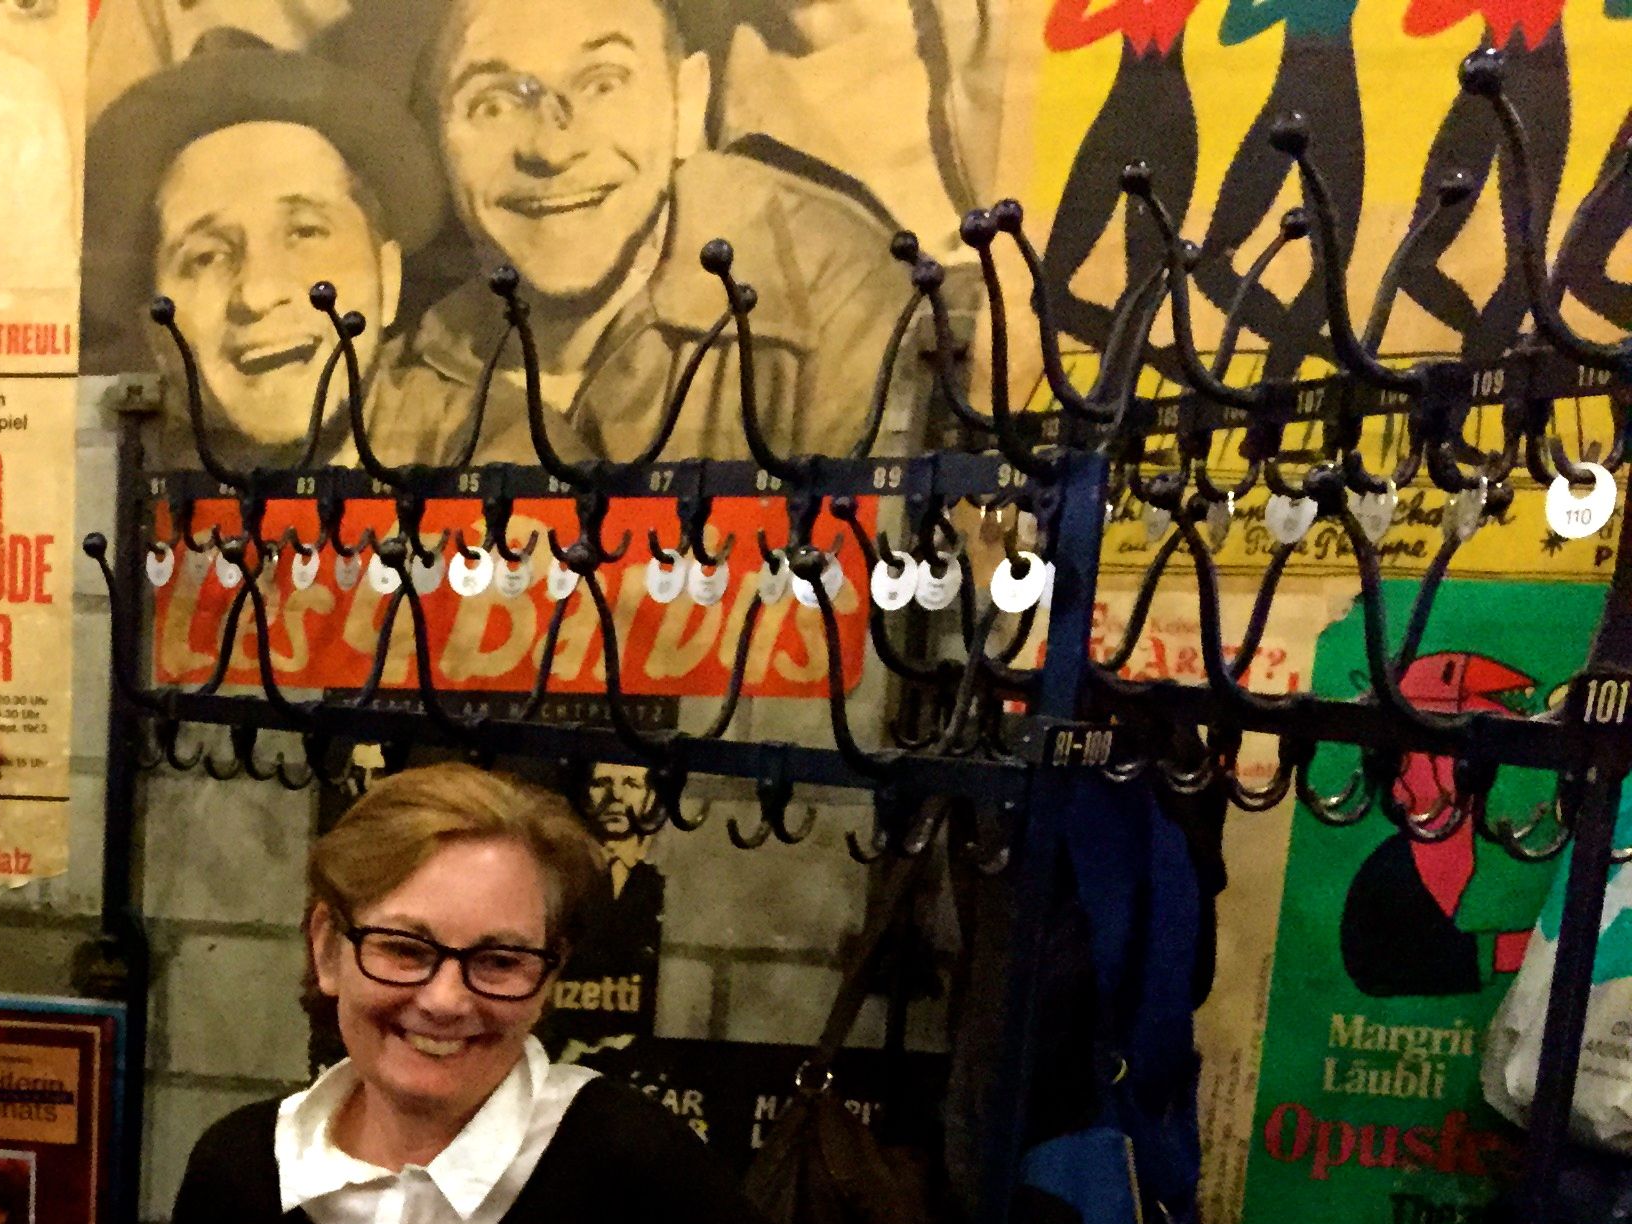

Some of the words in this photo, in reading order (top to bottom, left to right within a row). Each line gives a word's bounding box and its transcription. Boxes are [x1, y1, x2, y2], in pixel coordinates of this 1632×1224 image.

[1565, 506, 1593, 526] 110
[1583, 678, 1631, 725] 101
[1328, 1013, 1474, 1062] Margrit
[1321, 1056, 1447, 1100] Läubli
